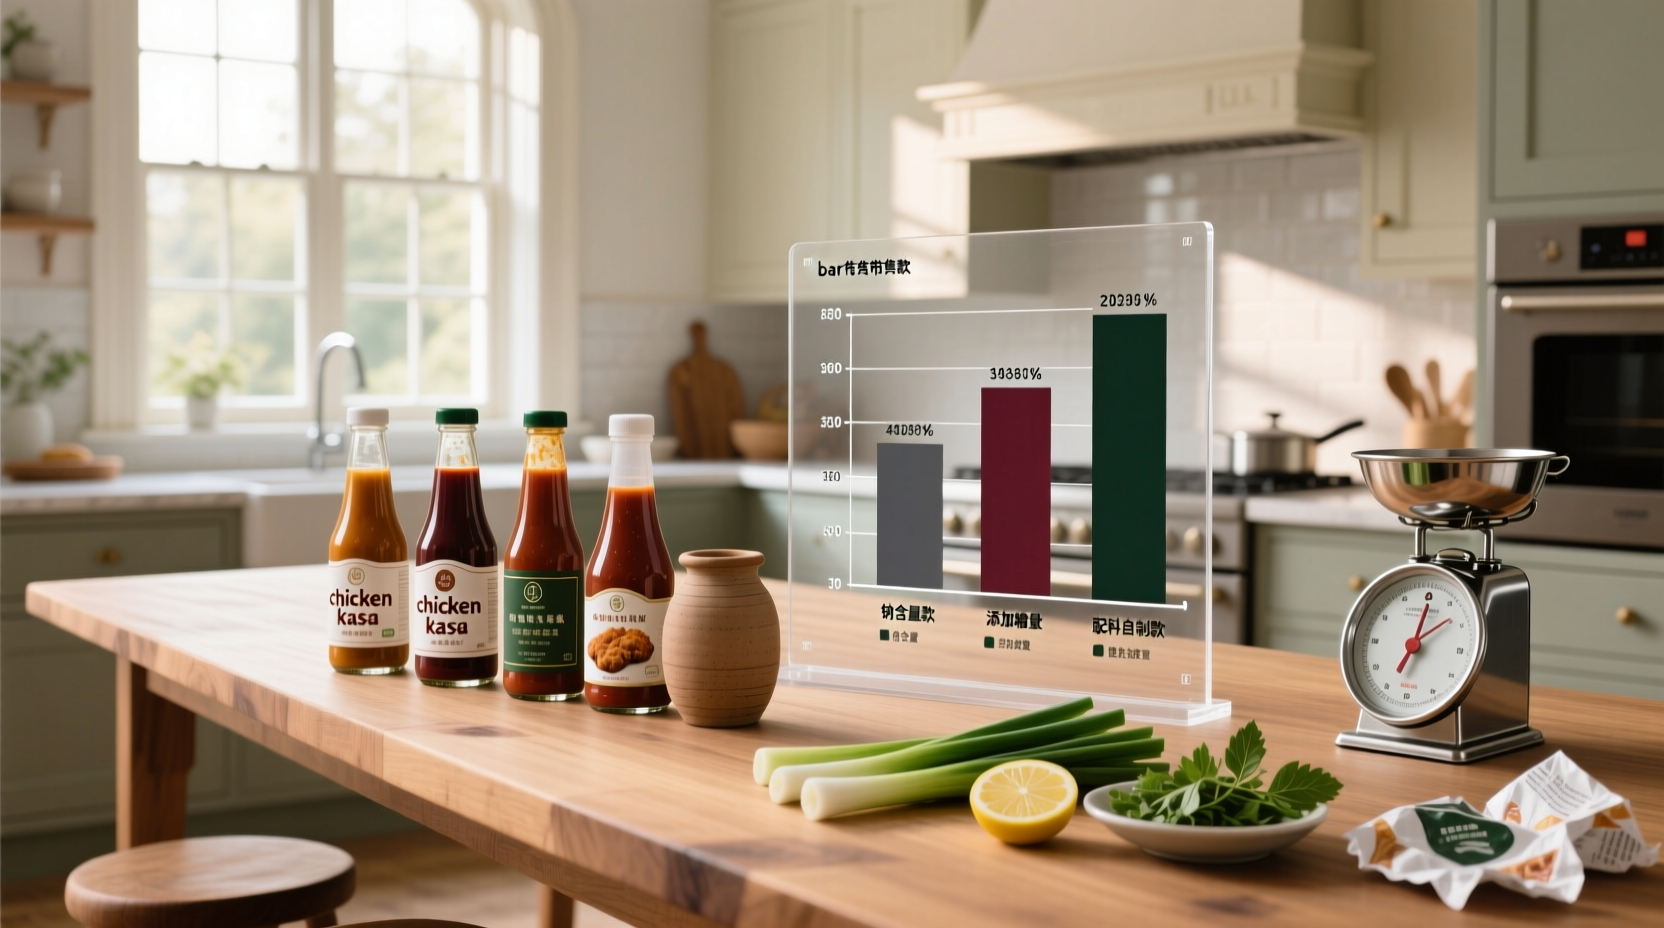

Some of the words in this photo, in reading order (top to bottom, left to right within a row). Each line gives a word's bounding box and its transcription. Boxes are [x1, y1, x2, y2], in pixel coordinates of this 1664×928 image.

[329, 588, 393, 607] chicken
[416, 594, 481, 615] chicken
[337, 607, 379, 626] kasa
[426, 616, 468, 635] kasa
